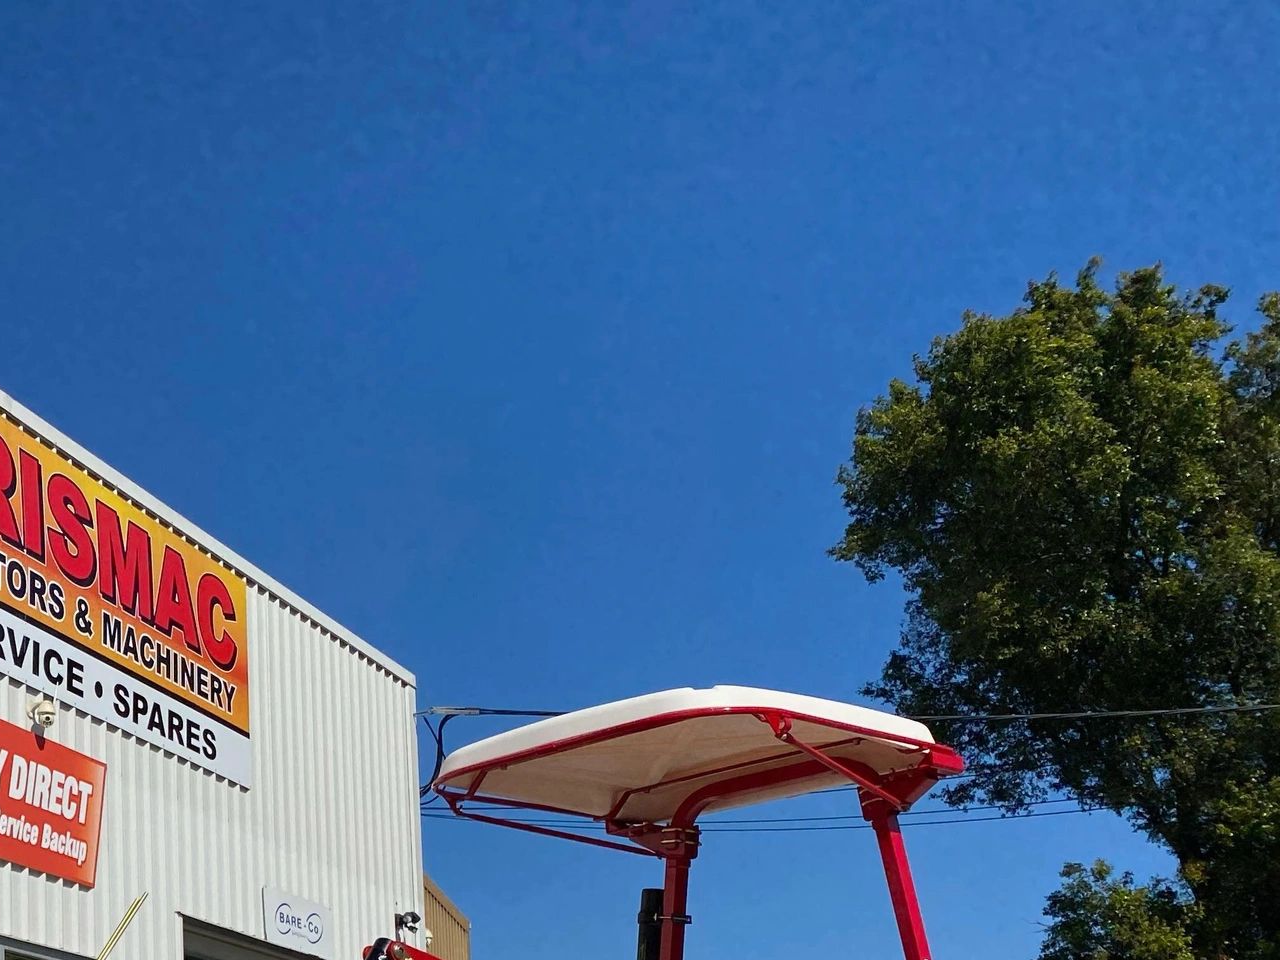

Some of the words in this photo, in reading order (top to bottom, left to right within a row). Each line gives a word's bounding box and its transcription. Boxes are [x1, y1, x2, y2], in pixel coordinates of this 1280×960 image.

[75, 598, 93, 636] &
[102, 612, 236, 713] MACHINERY
[113, 684, 217, 760] SPARES
[8, 754, 93, 825] DIRECT
[41, 824, 87, 866] Backup
